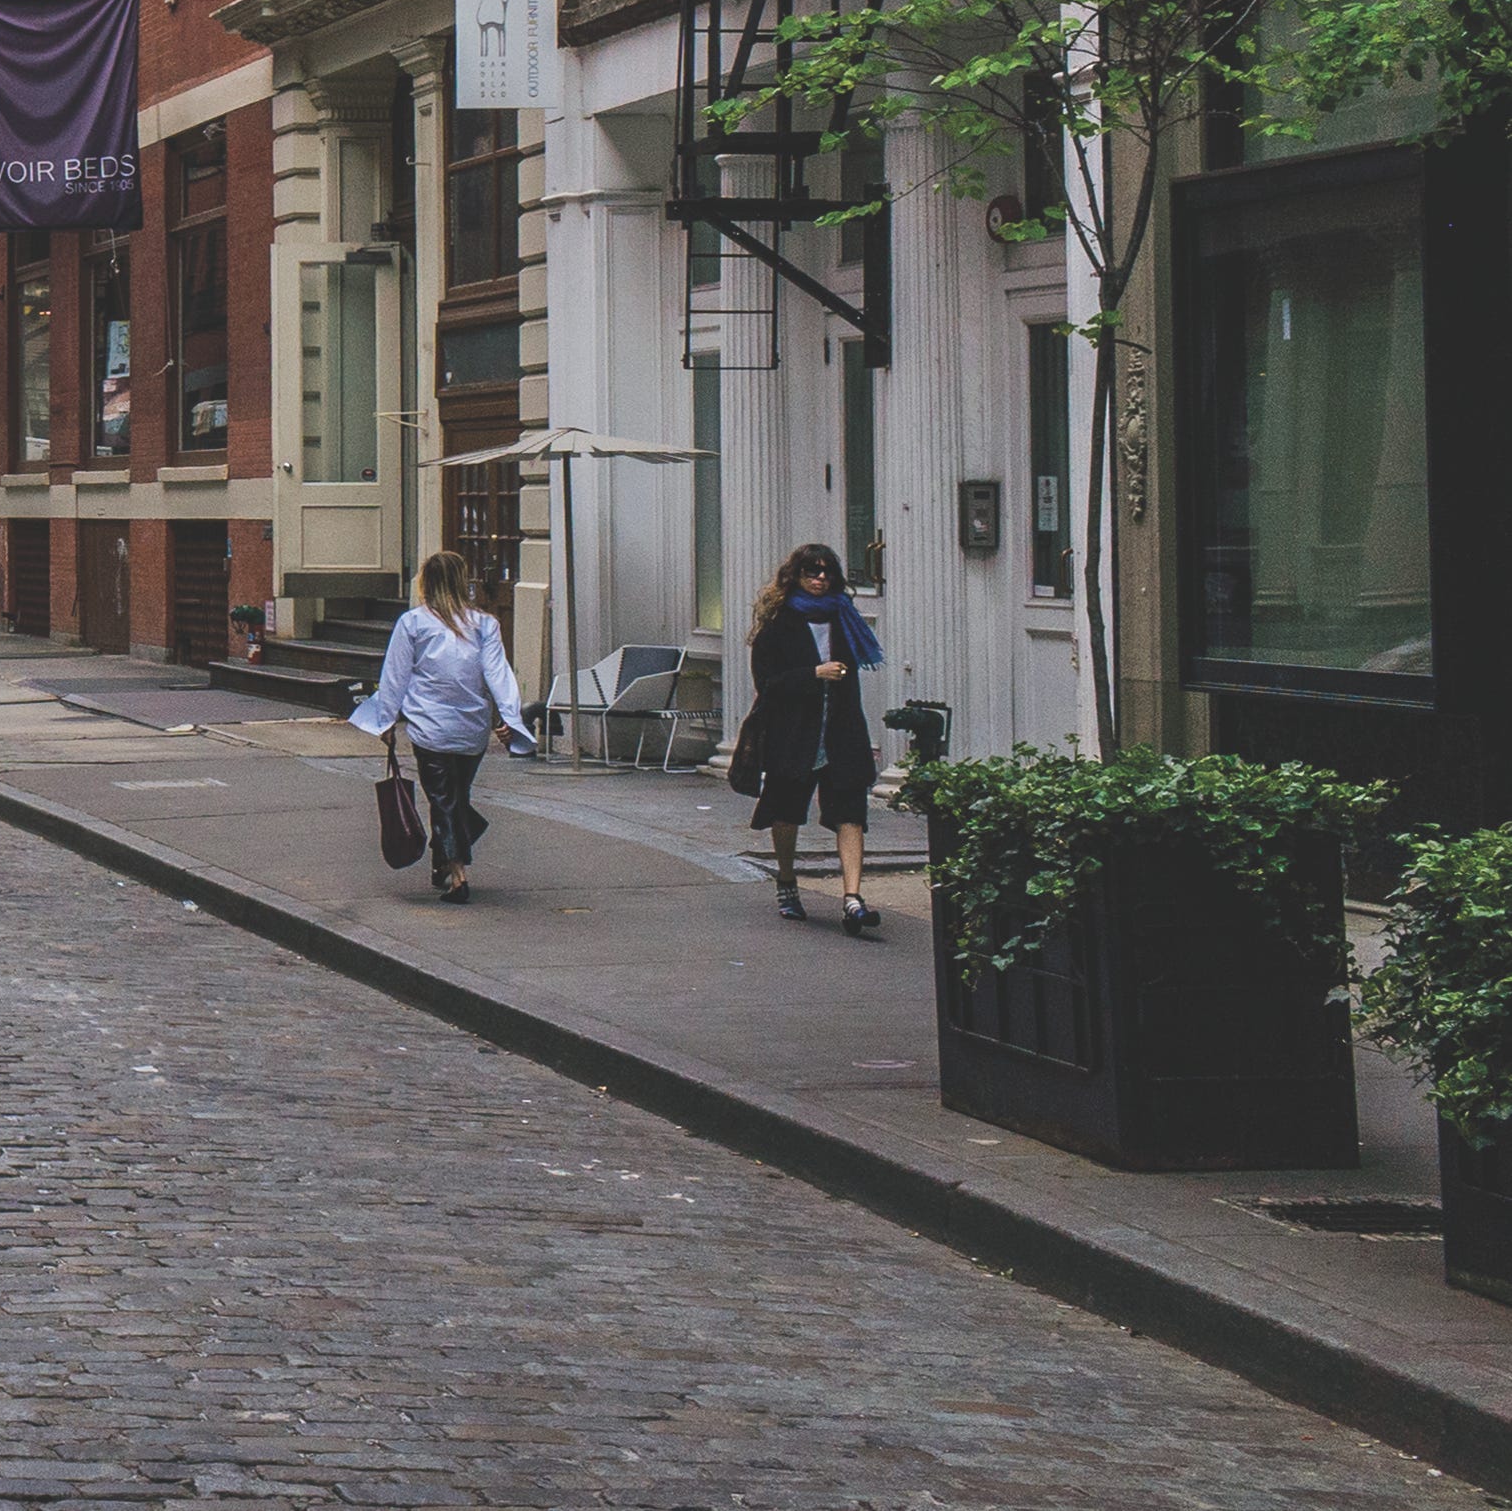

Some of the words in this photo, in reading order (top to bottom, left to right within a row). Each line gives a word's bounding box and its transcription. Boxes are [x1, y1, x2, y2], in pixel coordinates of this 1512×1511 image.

[527, 41, 539, 98] OUTDOOR
[64, 154, 136, 181] BEDS
[65, 180, 105, 194] SINCE
[109, 178, 135, 192] 1905
